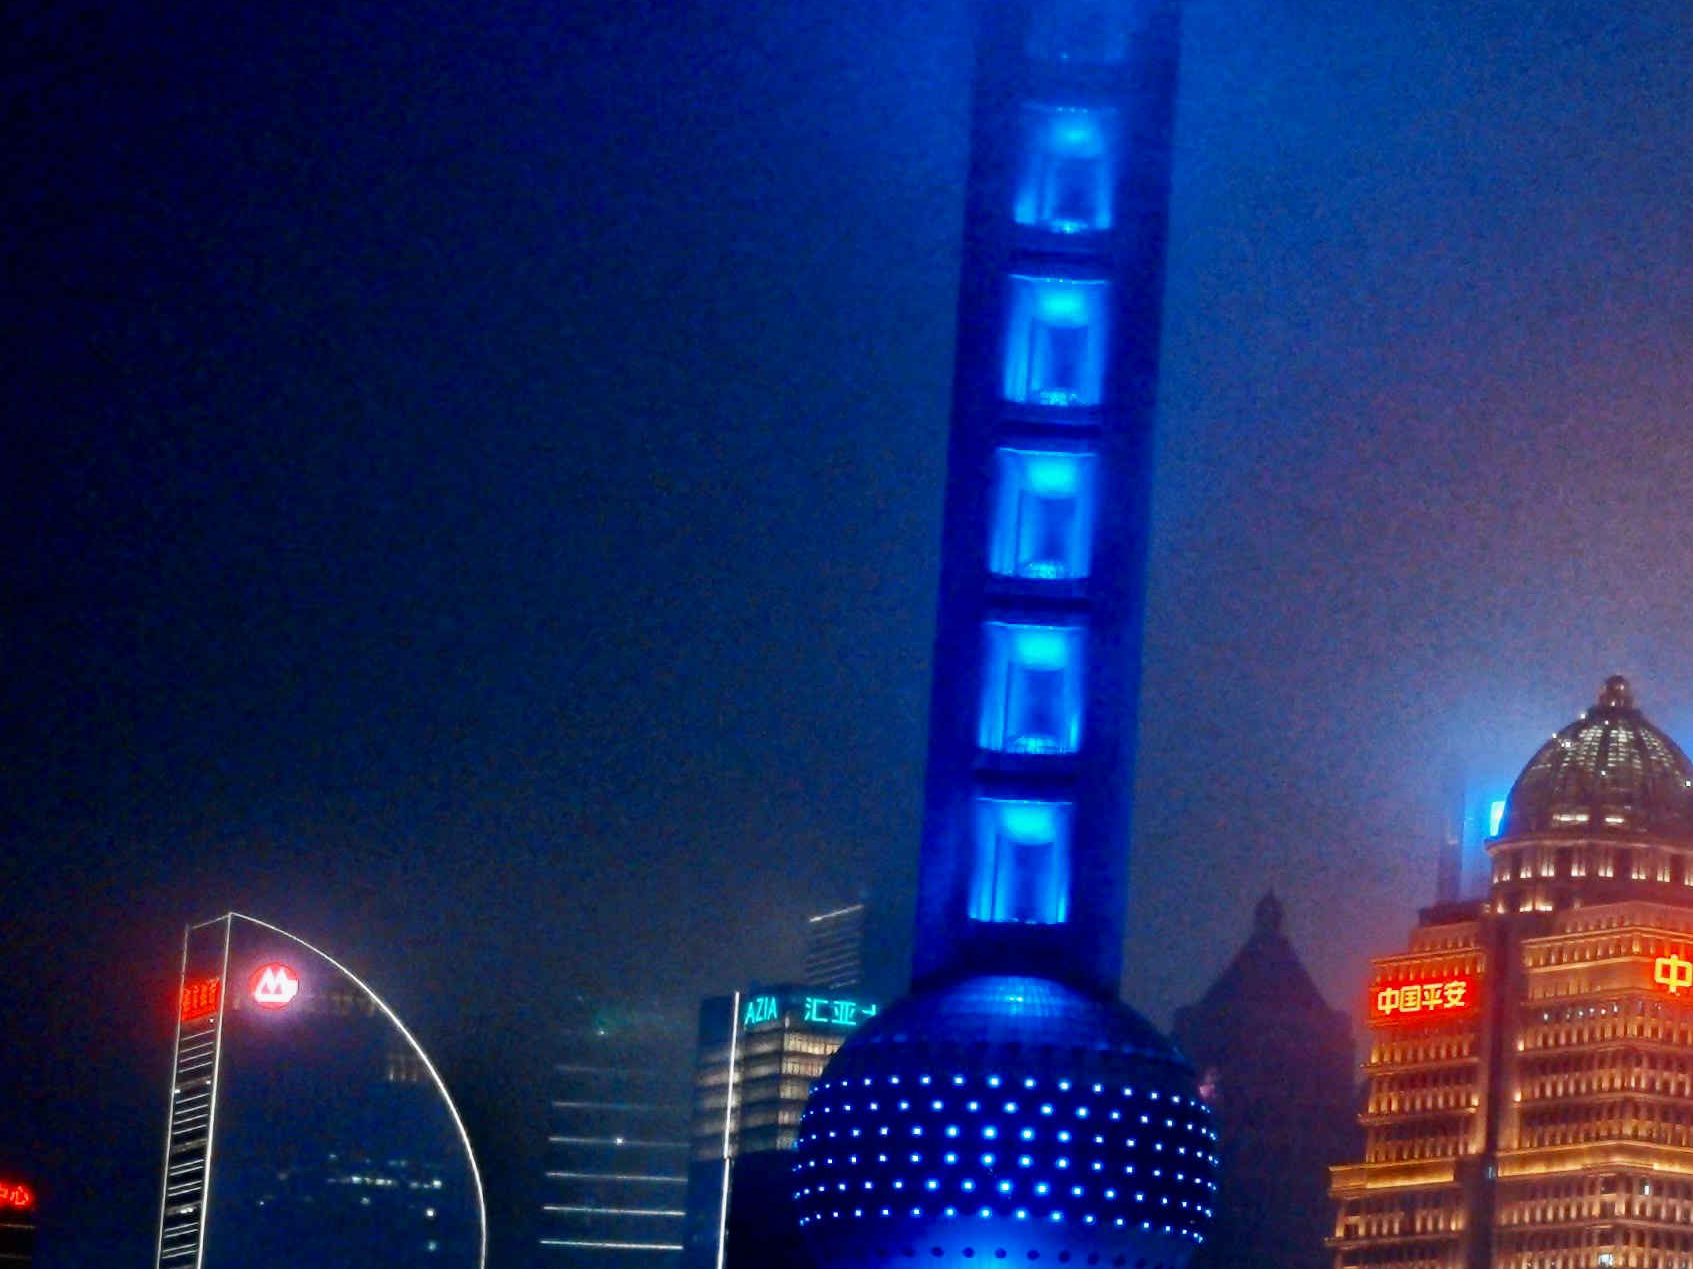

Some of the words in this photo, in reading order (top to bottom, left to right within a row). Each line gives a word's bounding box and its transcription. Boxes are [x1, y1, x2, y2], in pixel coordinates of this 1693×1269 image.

[745, 996, 778, 1025] AZIA
[1377, 979, 1467, 1016] 中国平安
